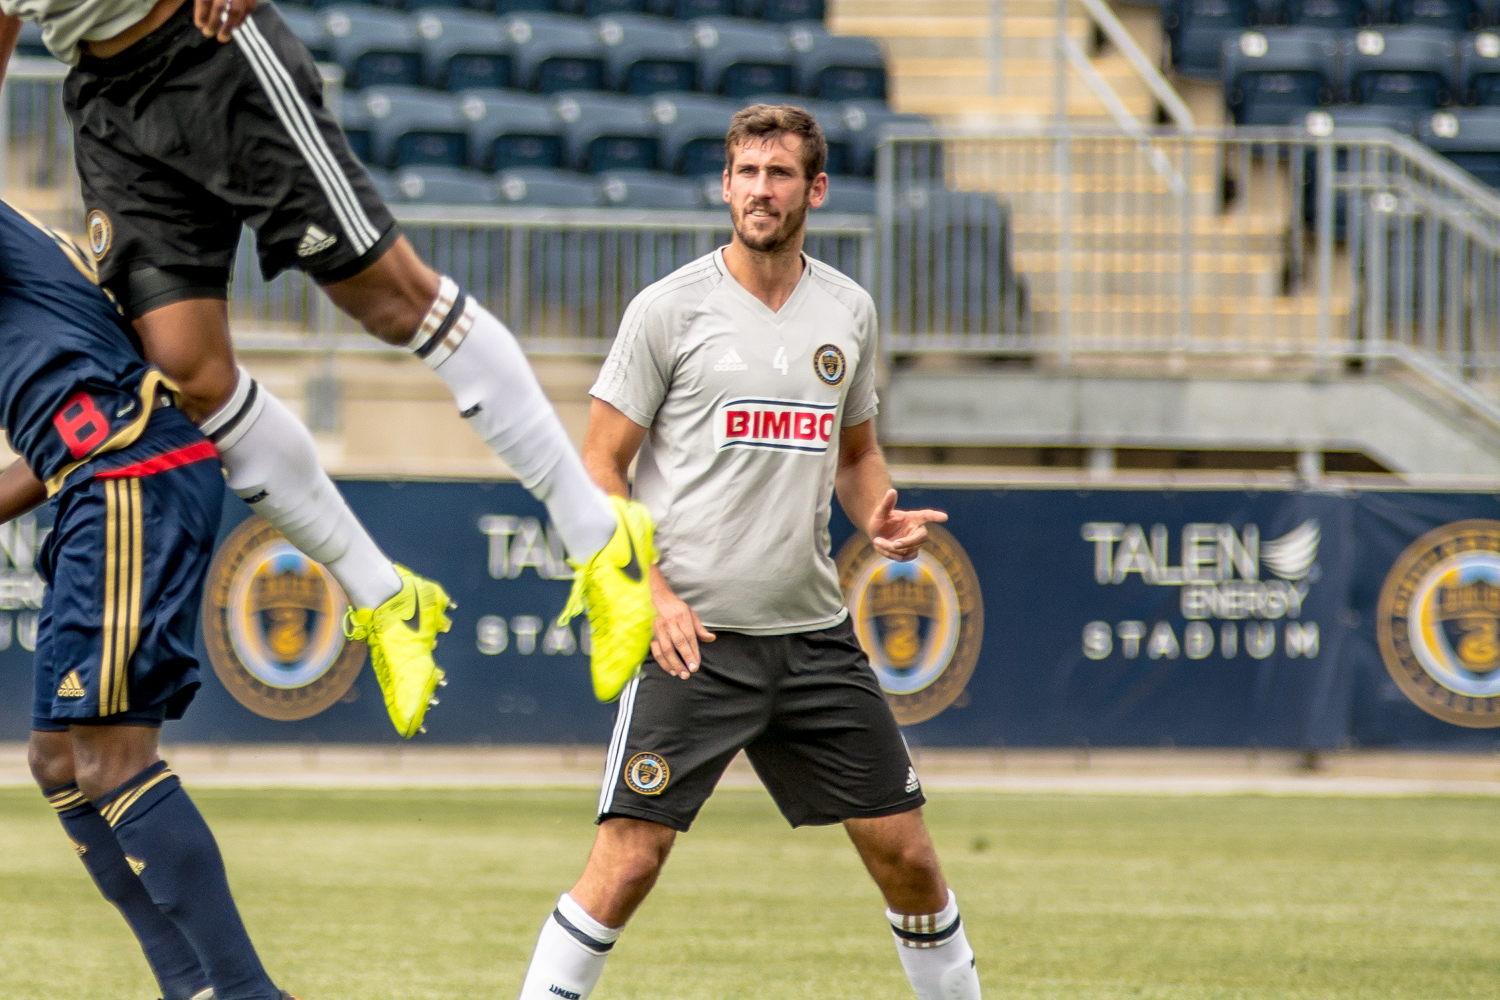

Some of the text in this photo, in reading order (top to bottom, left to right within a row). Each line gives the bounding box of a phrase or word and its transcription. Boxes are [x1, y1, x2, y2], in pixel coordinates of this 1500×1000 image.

[298, 234, 337, 257] adidas
[772, 346, 789, 376] 4
[725, 410, 836, 443] BIMBO
[1080, 521, 1260, 586] TALEN
[1180, 580, 1309, 620] ENERGY
[1081, 620, 1320, 660] STADIUM
